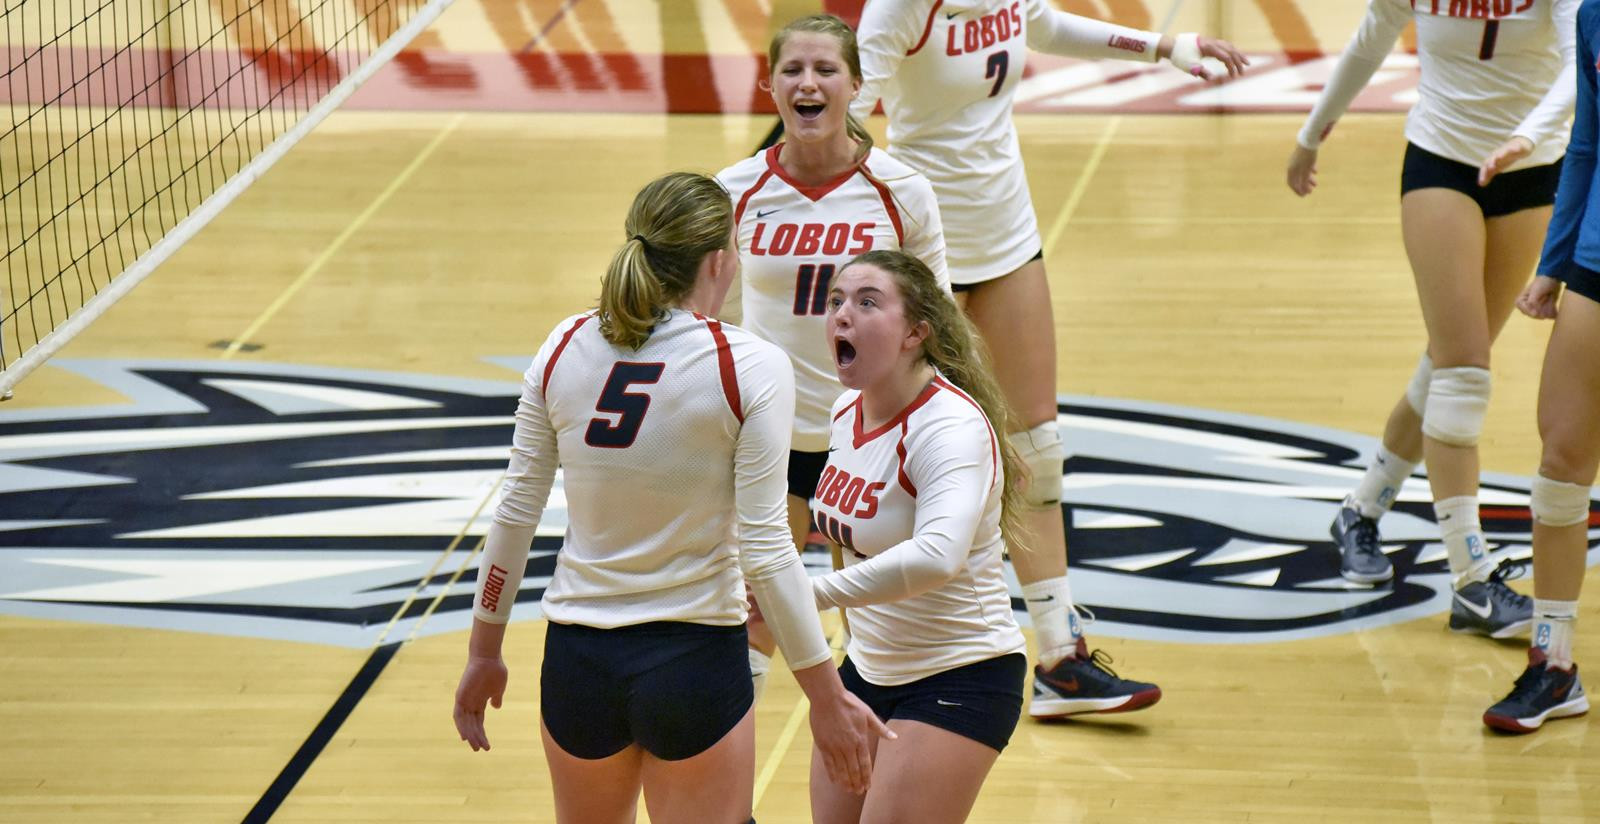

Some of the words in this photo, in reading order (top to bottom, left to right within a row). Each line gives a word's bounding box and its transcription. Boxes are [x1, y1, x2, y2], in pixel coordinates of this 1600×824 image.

[946, 1, 1021, 56] LOBOS
[1108, 34, 1147, 53] LOBOS
[985, 50, 1009, 98] 7
[750, 222, 877, 256] LOBOS
[793, 263, 836, 316] 11
[584, 360, 666, 449] 5
[815, 464, 887, 519] OBOS
[481, 564, 508, 613] LOBOS
